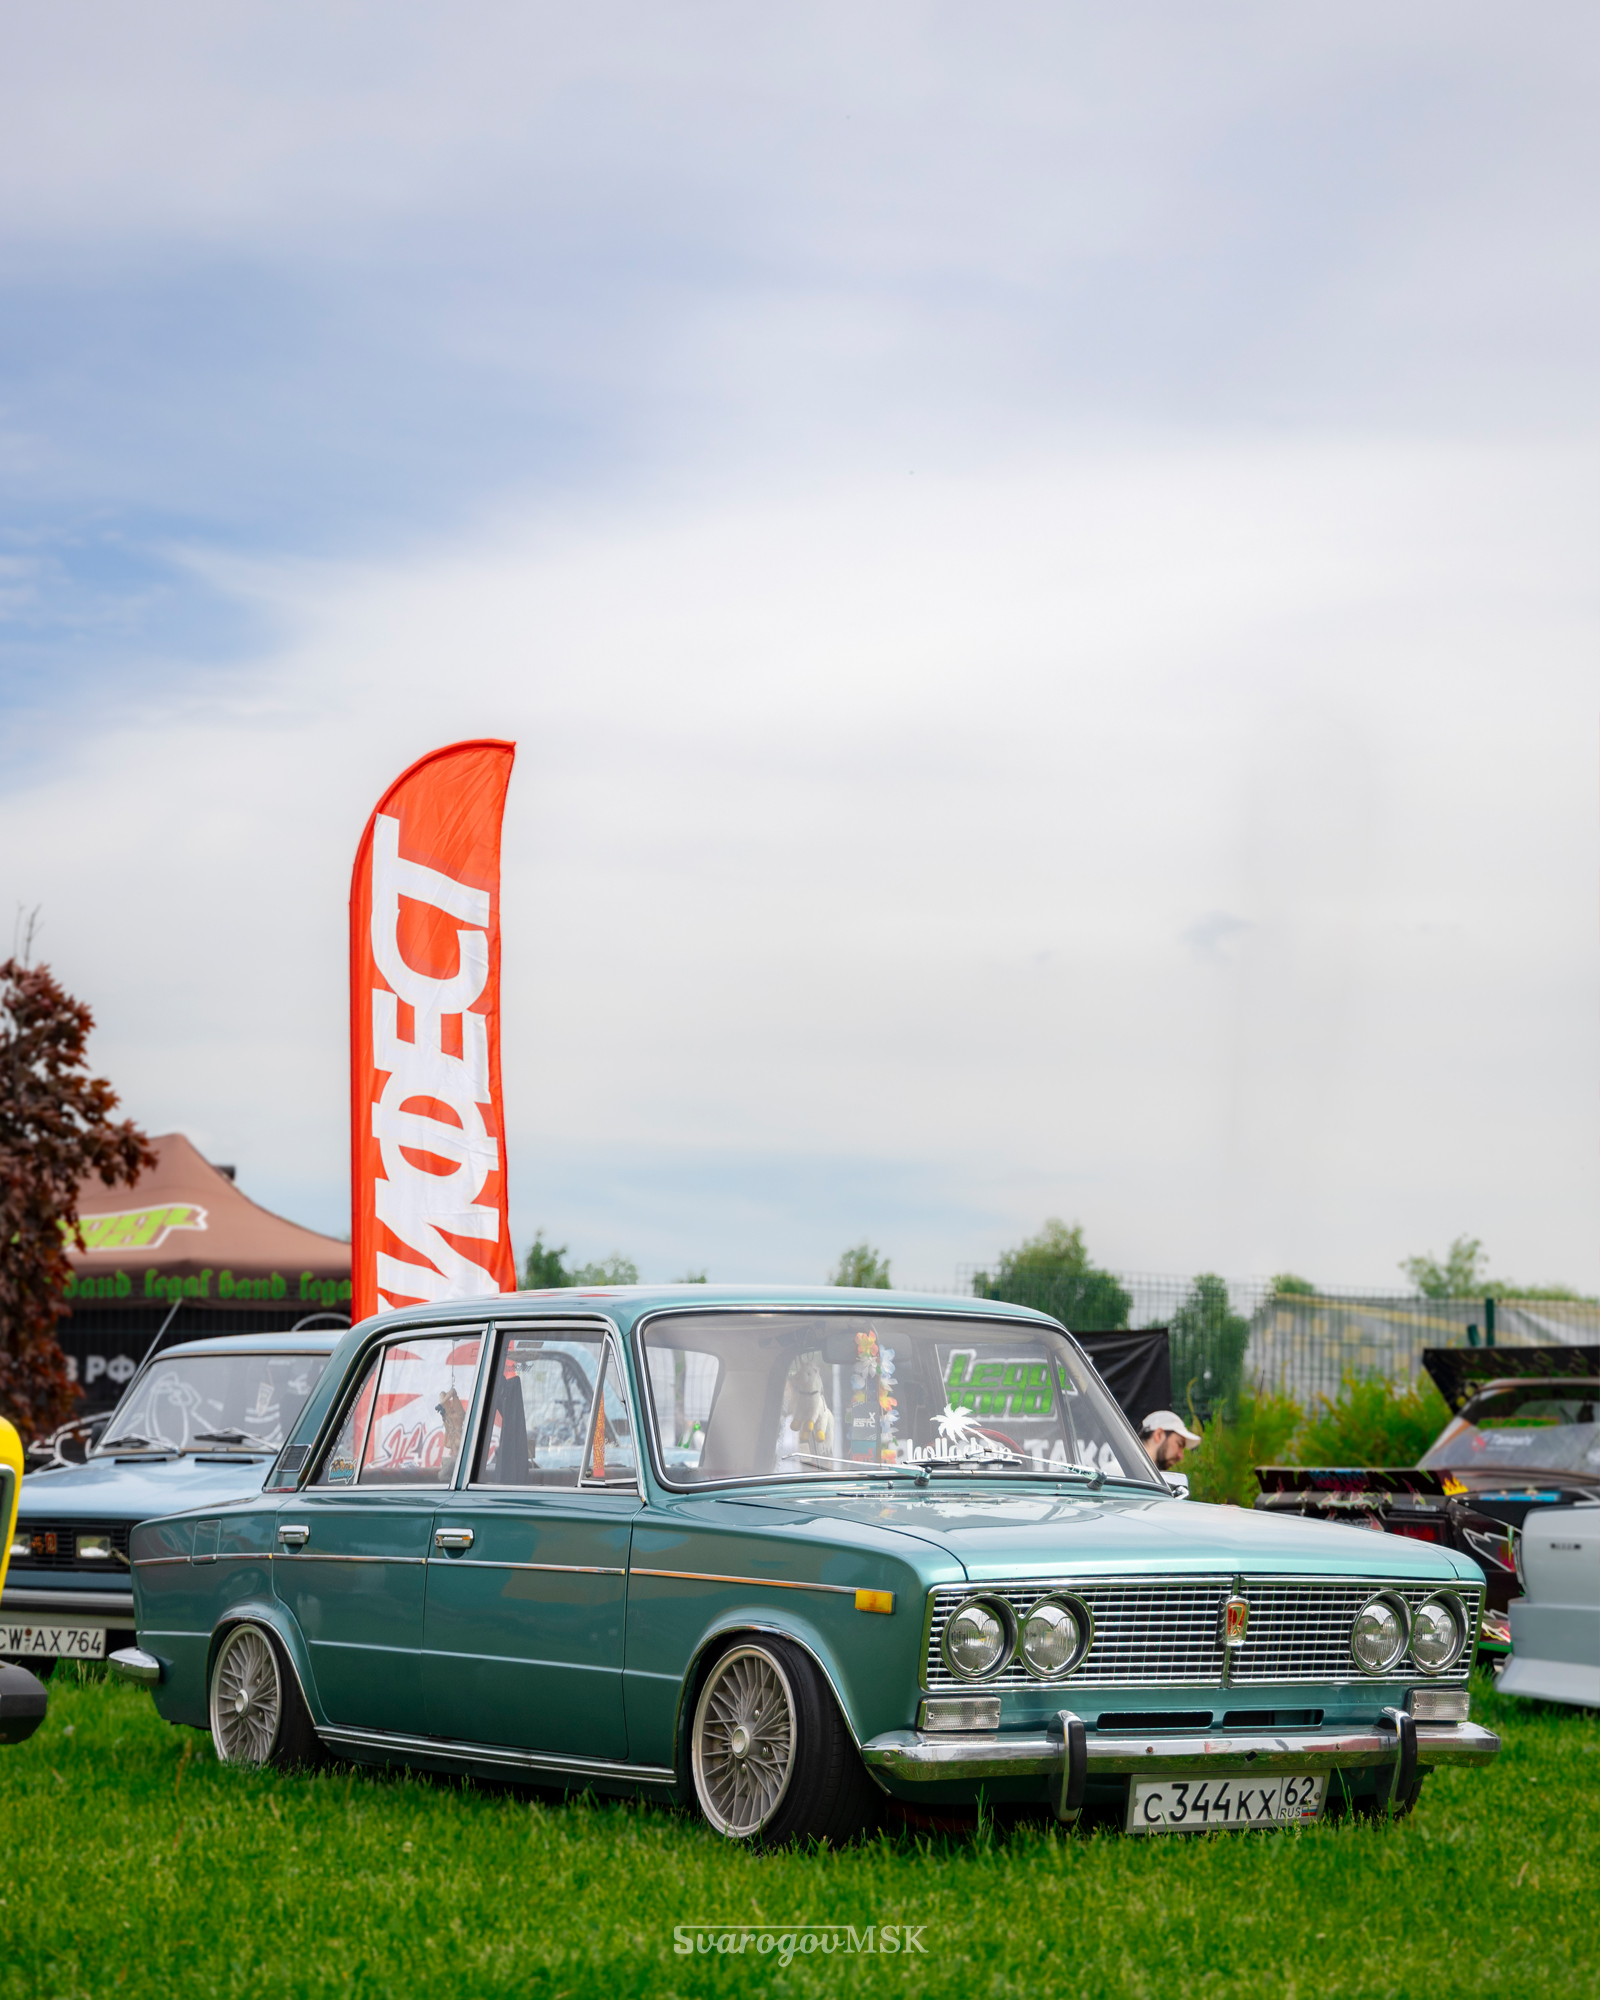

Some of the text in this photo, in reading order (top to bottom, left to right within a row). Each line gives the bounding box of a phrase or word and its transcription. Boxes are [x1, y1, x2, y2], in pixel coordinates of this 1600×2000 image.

[300, 1271, 352, 1307] lega
[1284, 1776, 1315, 1806] 62
[1280, 1806, 1300, 1819] RUS
